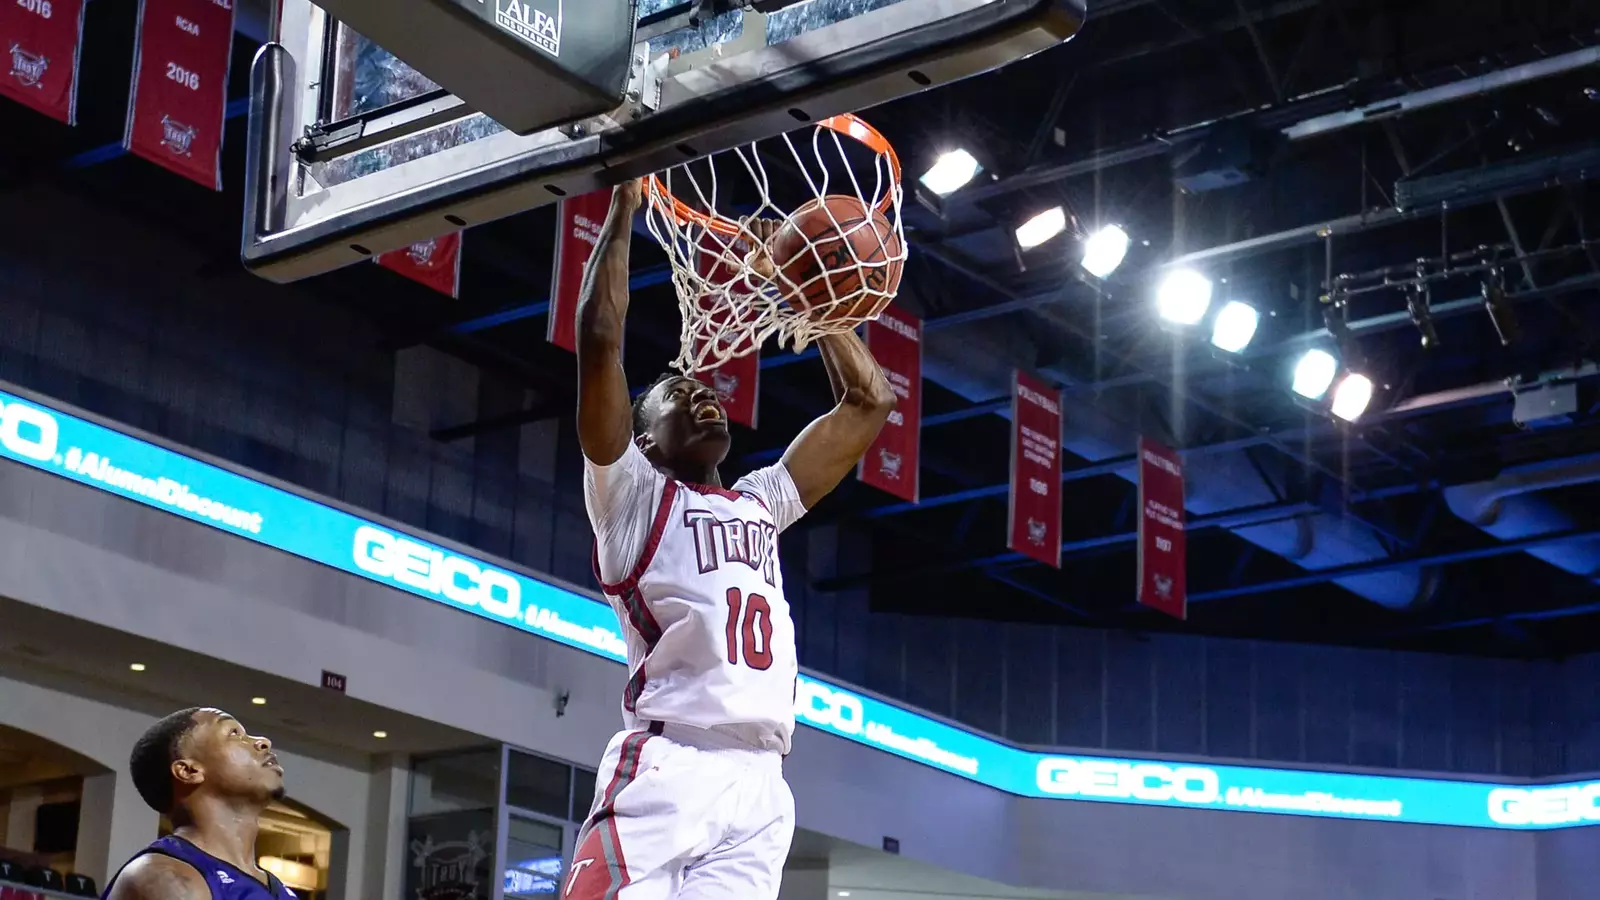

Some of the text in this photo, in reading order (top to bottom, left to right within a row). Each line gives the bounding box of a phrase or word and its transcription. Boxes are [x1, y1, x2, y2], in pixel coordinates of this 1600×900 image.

[175, 15, 200, 36] NCAA
[500, 15, 556, 52] INSURANCE
[505, 0, 558, 41] ALFA
[684, 509, 777, 588] TROY
[353, 525, 521, 619] GEICO
[726, 587, 773, 671] 10
[327, 675, 342, 689] 104
[1037, 757, 1219, 804] GEICO
